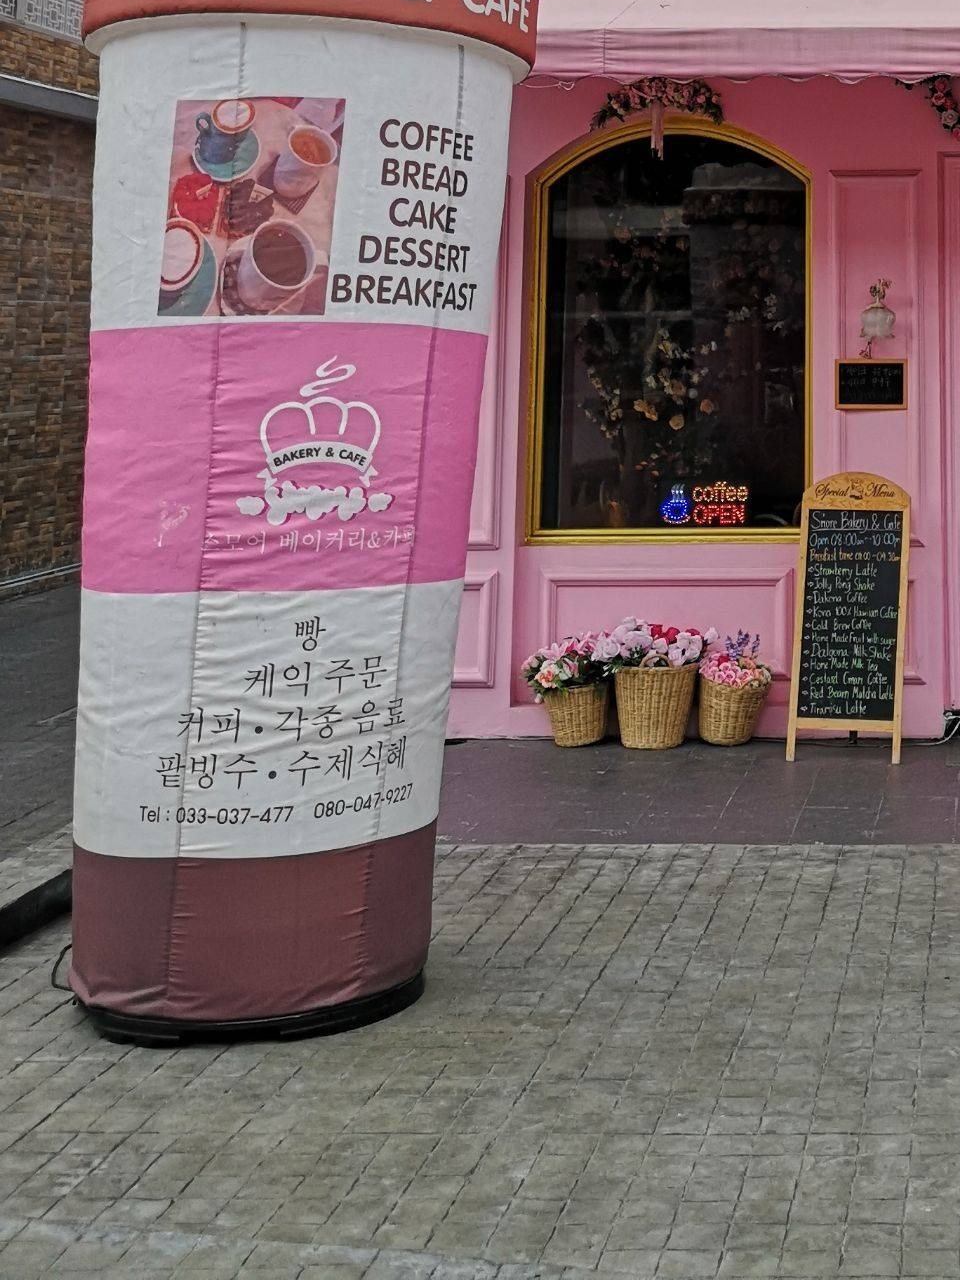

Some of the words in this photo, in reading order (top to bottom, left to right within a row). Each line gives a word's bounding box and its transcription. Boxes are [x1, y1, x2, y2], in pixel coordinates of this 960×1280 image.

[379, 118, 474, 162] COFFEE
[381, 158, 468, 198] BREAD
[388, 197, 457, 235] CAKE
[358, 234, 470, 274] DESSERT
[330, 273, 477, 311] BREAKFAST
[273, 446, 322, 467] BAKERY
[325, 446, 336, 457] &
[338, 448, 367, 467] CAFE
[693, 481, 748, 502] coffee
[815, 483, 850, 500] Special
[865, 482, 895, 498] Menu
[693, 504, 745, 524] OPEN
[295, 615, 327, 651] 빵
[244, 663, 311, 698] 케익
[323, 655, 388, 694] 주문
[177, 707, 240, 743] 커피
[275, 704, 346, 742] 각종
[352, 697, 405, 736] 음료
[155, 753, 258, 790] 팥빙수
[287, 734, 407, 787] 수제식혜
[139, 805, 160, 823] Tel
[176, 805, 294, 825] 033-037-477
[313, 783, 413, 819] 080-047-9227
